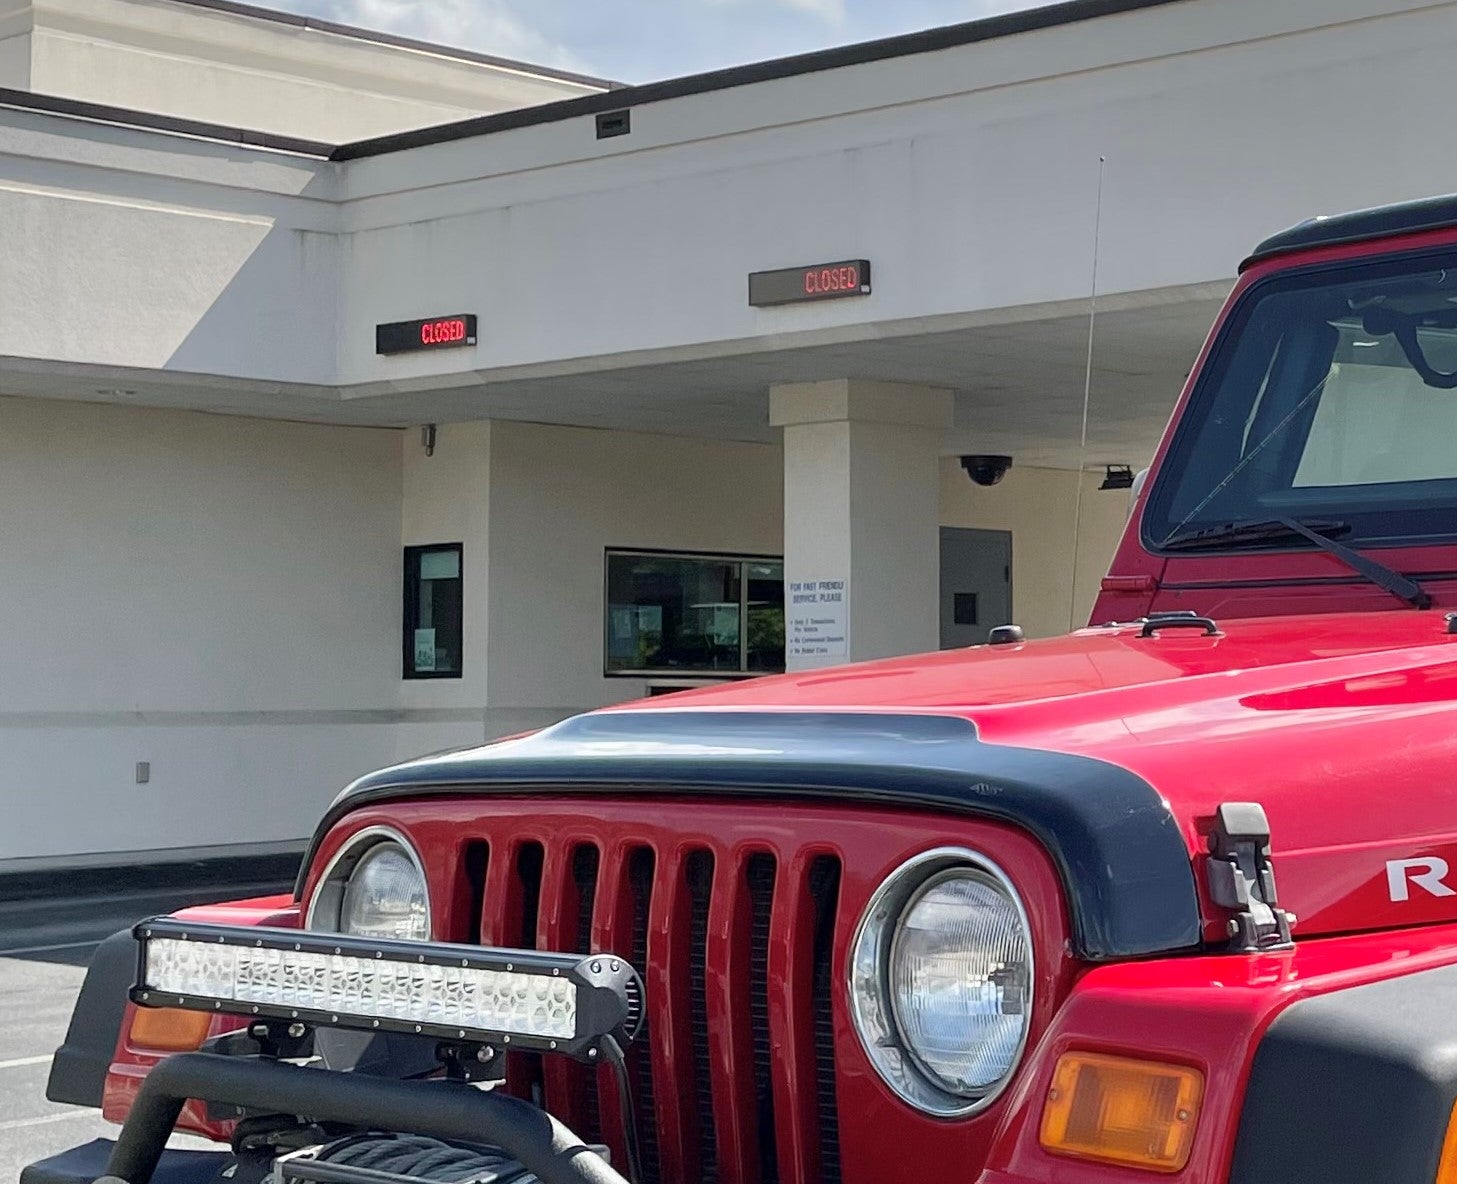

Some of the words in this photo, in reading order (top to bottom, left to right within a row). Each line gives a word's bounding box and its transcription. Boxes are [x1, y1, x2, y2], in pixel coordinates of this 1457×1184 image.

[803, 265, 858, 294] CLOSED
[420, 320, 465, 345] CLOSED
[790, 583, 802, 592] FOR
[803, 583, 817, 592] FAST
[820, 593, 842, 603] PLEASE
